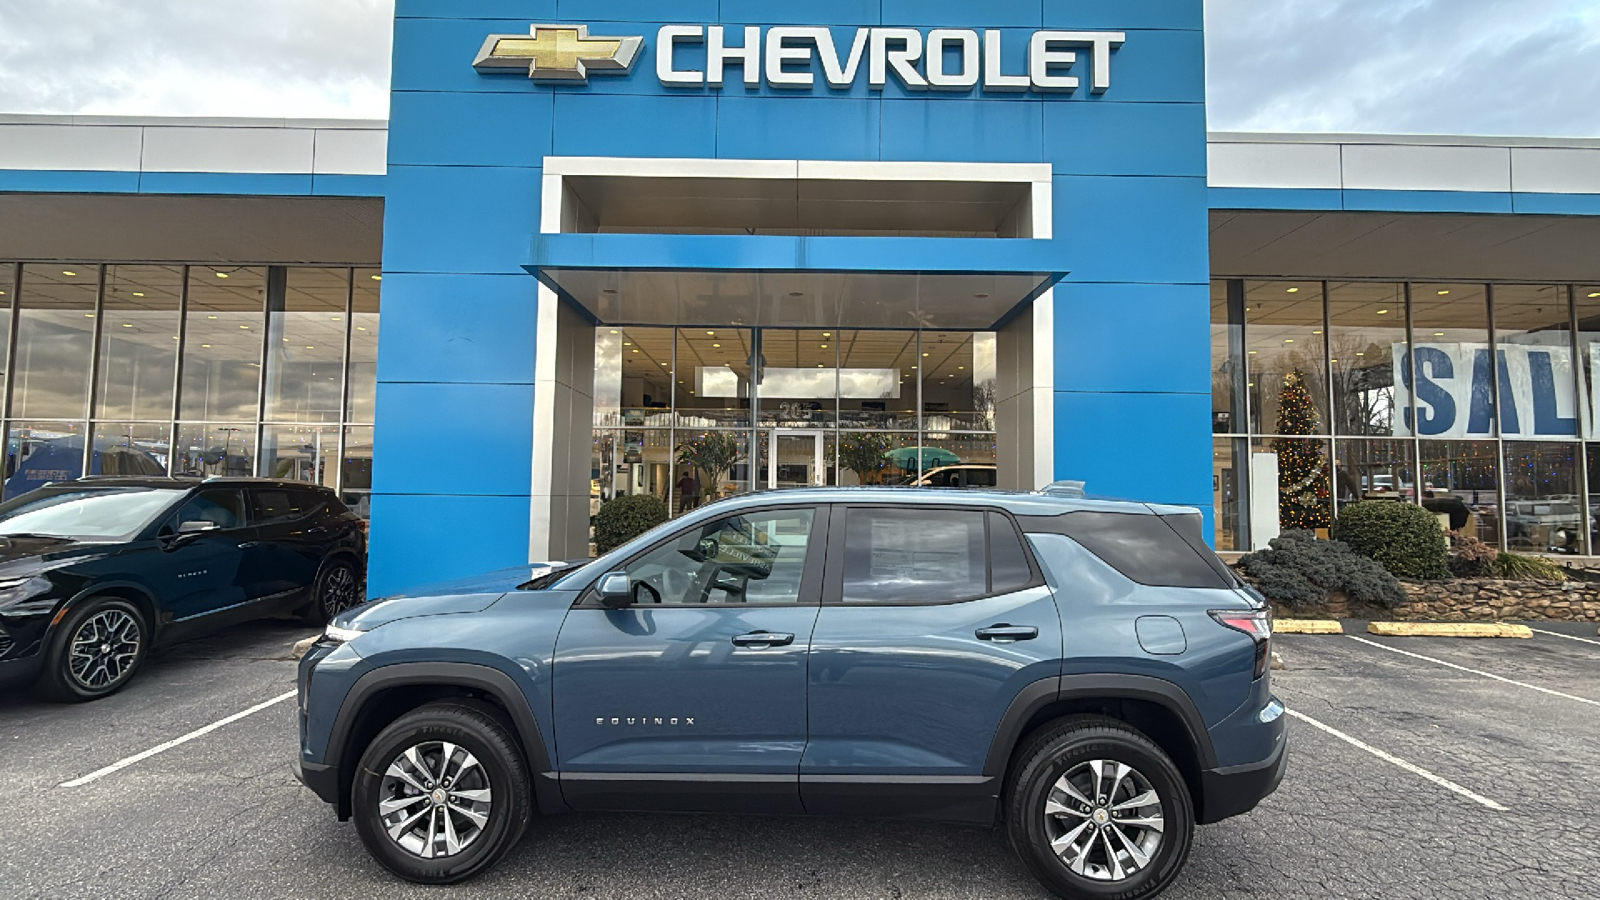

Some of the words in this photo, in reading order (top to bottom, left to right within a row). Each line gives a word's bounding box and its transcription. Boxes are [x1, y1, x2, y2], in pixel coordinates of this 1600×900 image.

[656, 25, 1126, 95] CHEVROLET
[780, 401, 813, 419] 205
[596, 717, 695, 725] EQUINOX
